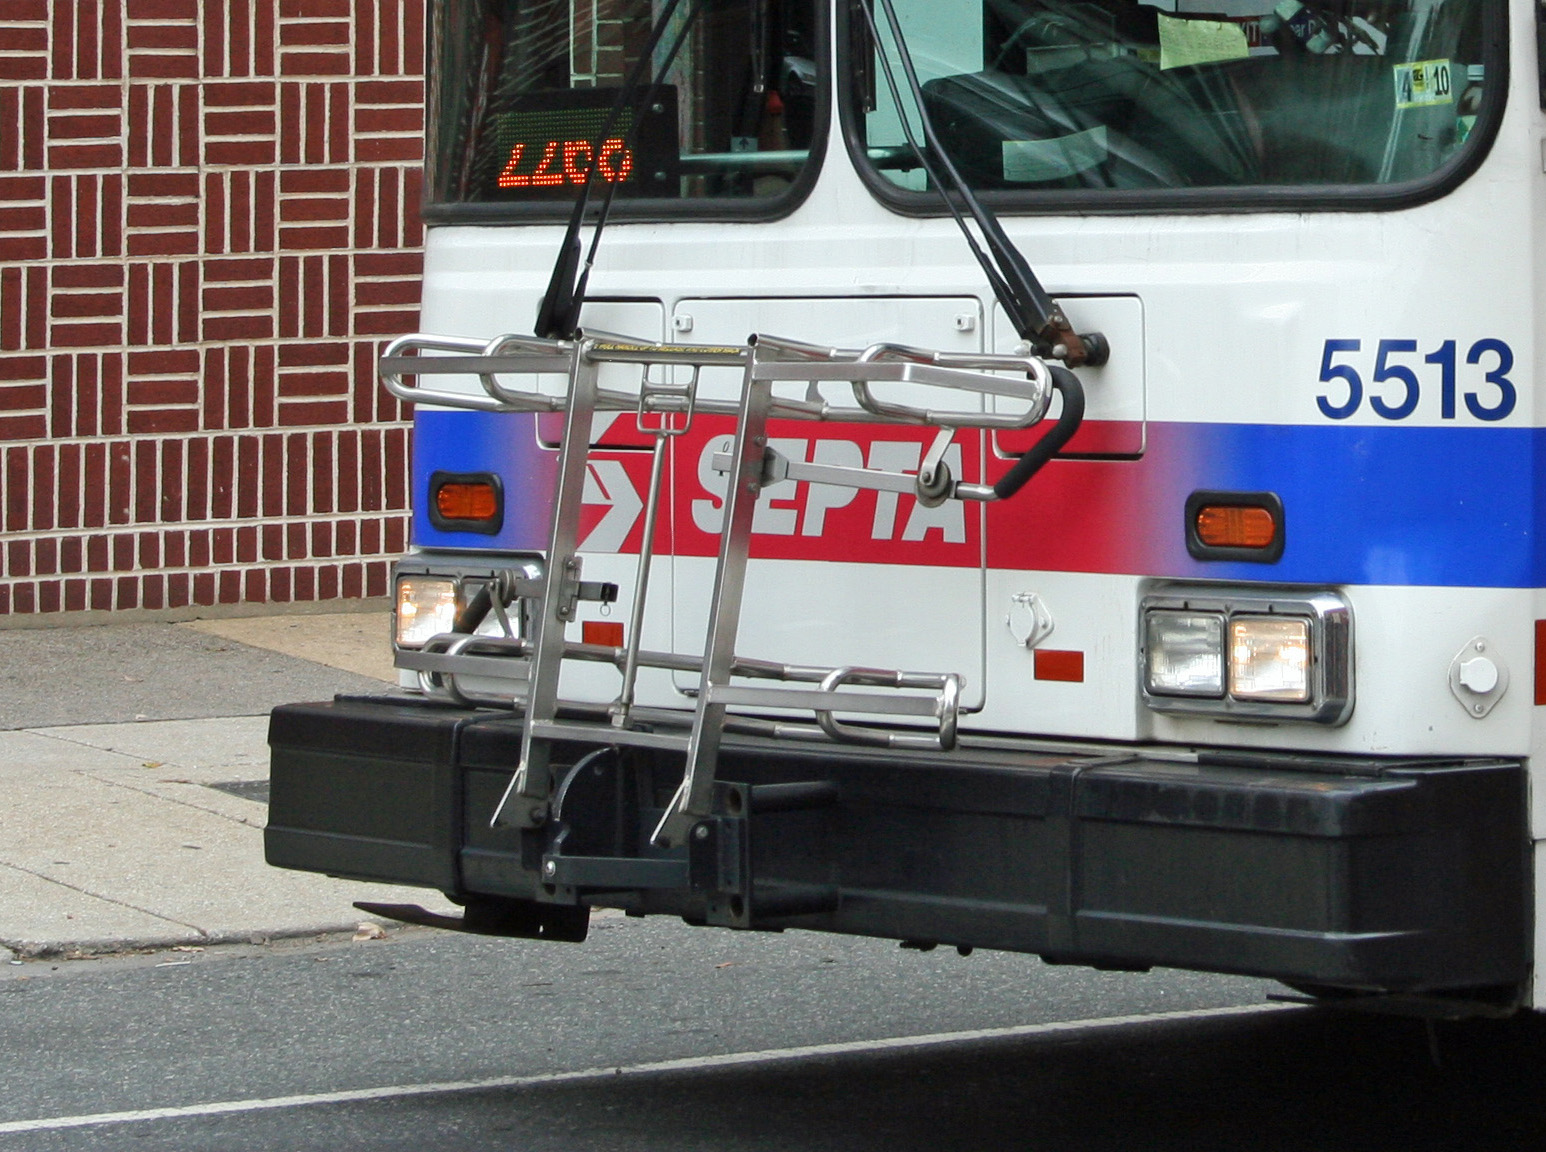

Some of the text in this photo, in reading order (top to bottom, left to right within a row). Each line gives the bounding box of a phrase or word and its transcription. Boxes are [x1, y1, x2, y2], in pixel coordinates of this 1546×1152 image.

[1434, 65, 1450, 96] 10
[1317, 338, 1518, 423] 5513
[690, 434, 967, 544] SEPTA
